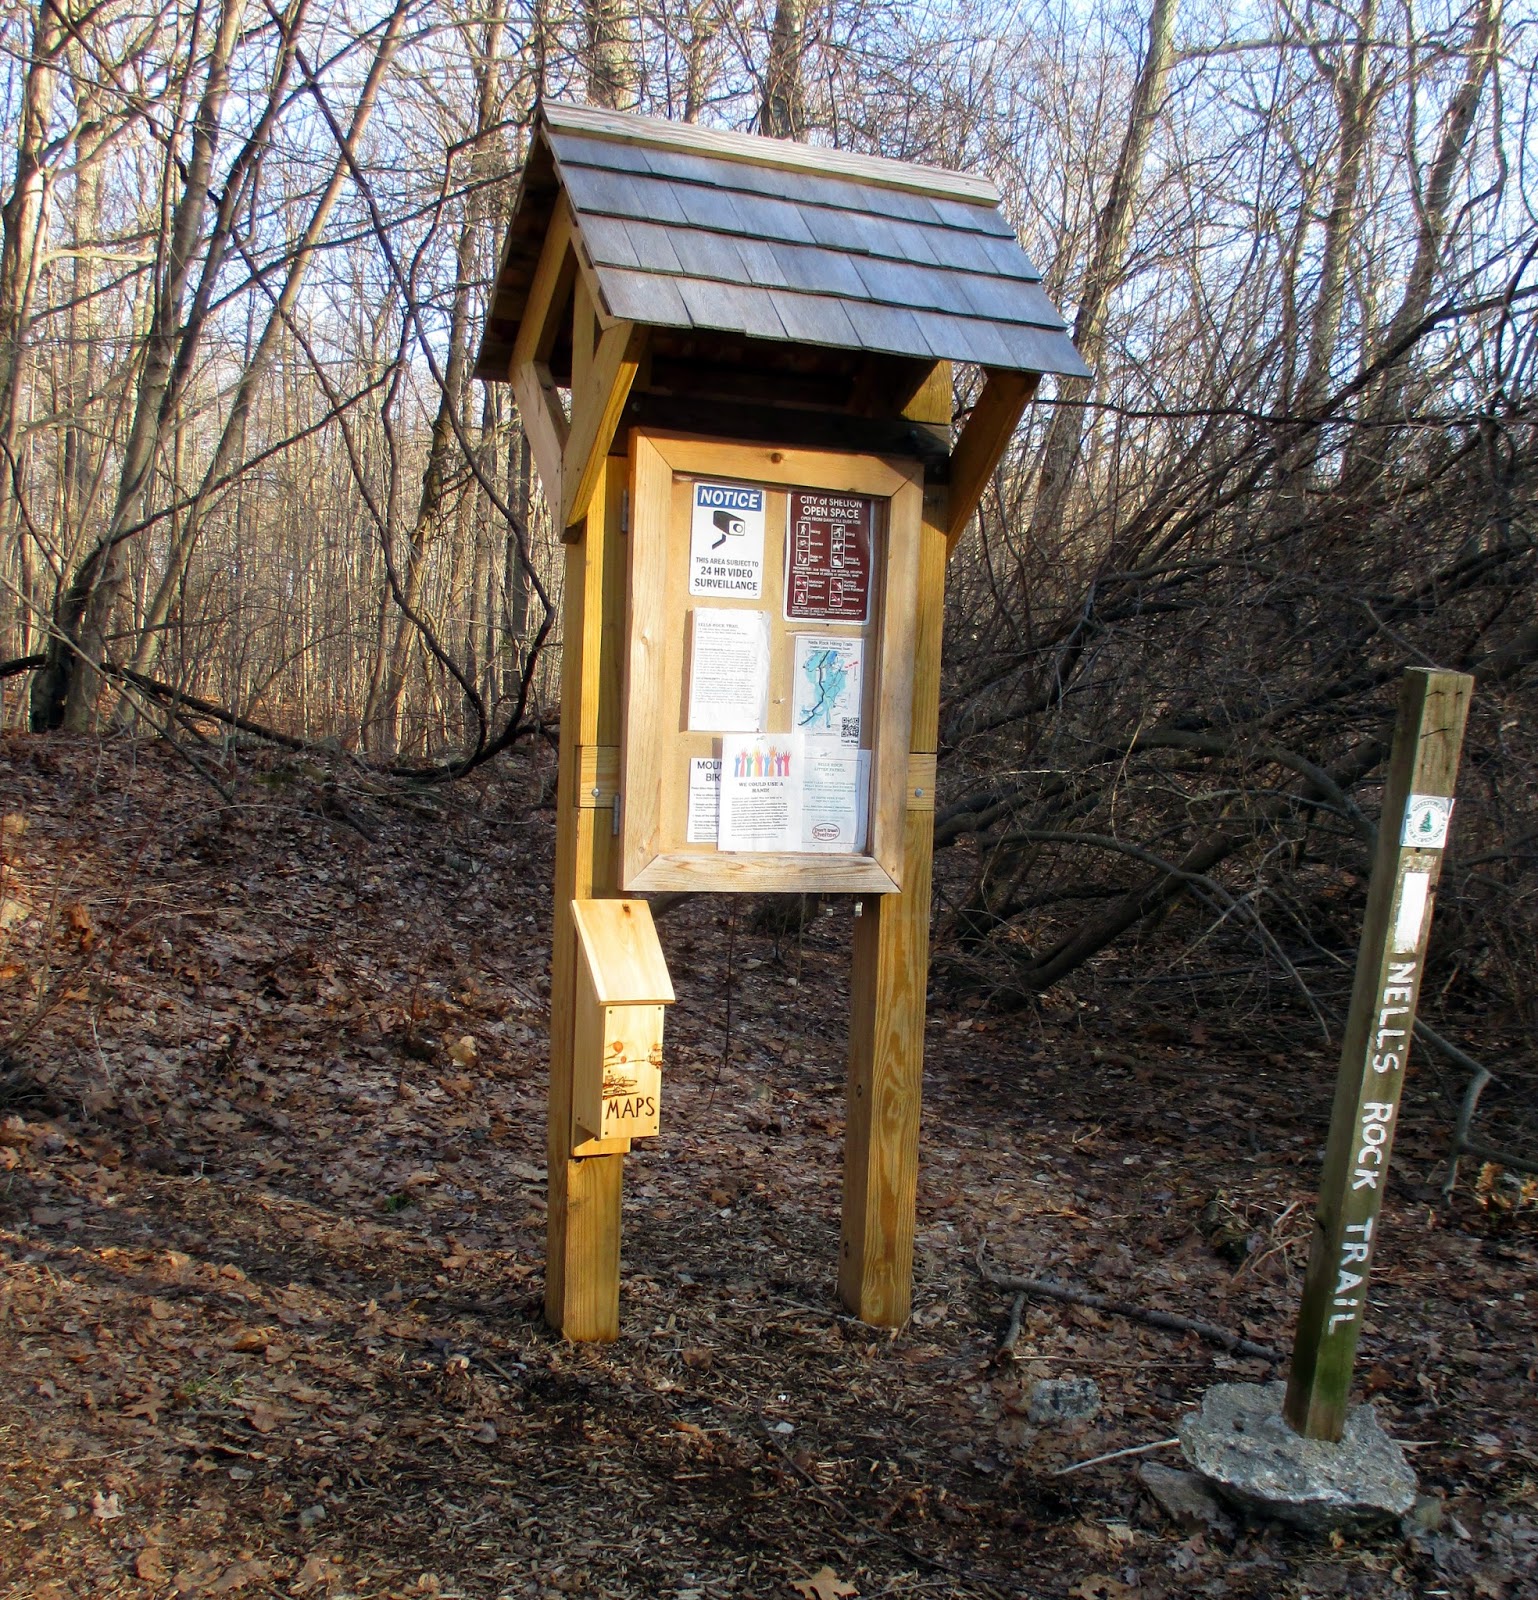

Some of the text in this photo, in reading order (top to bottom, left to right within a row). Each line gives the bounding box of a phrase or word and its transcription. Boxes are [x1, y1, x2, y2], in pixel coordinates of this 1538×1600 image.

[700, 489, 759, 508] NOTICE
[800, 495, 818, 504] CITY
[829, 498, 862, 508] SHELTON
[803, 506, 859, 518] OPEN SPACE
[726, 559, 751, 567] SUBJECT
[701, 566, 753, 578] 24 HR VIDEO
[695, 578, 757, 591] SURVEILLANCE
[1372, 962, 1416, 1073] NELL'S
[606, 1096, 655, 1120] MAPS
[1352, 1102, 1393, 1190] ROCK
